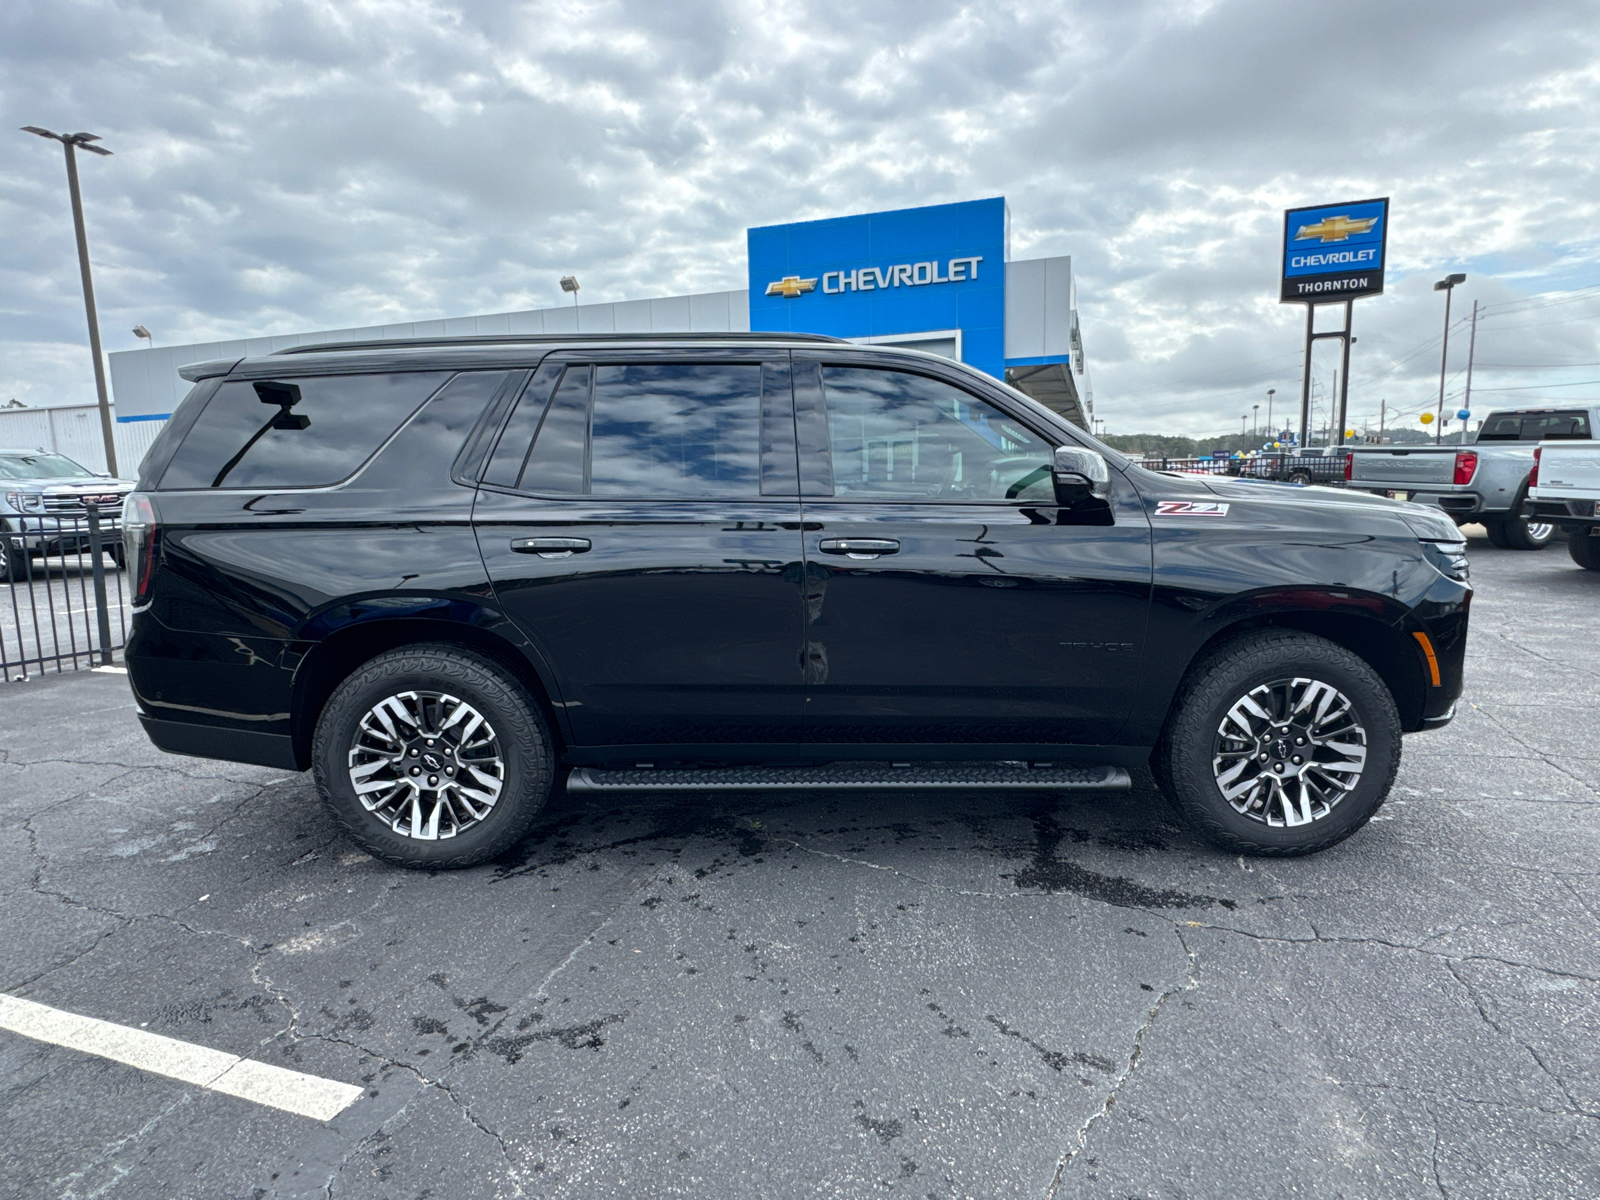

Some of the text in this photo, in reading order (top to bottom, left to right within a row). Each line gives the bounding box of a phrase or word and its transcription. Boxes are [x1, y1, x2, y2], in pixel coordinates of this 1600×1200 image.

[1291, 249, 1376, 268] CHEVROLET
[822, 255, 983, 295] CHEVROLET
[1297, 277, 1368, 294] THORNTON
[1154, 501, 1230, 516] Z71
[1059, 642, 1134, 653] TAHOE
